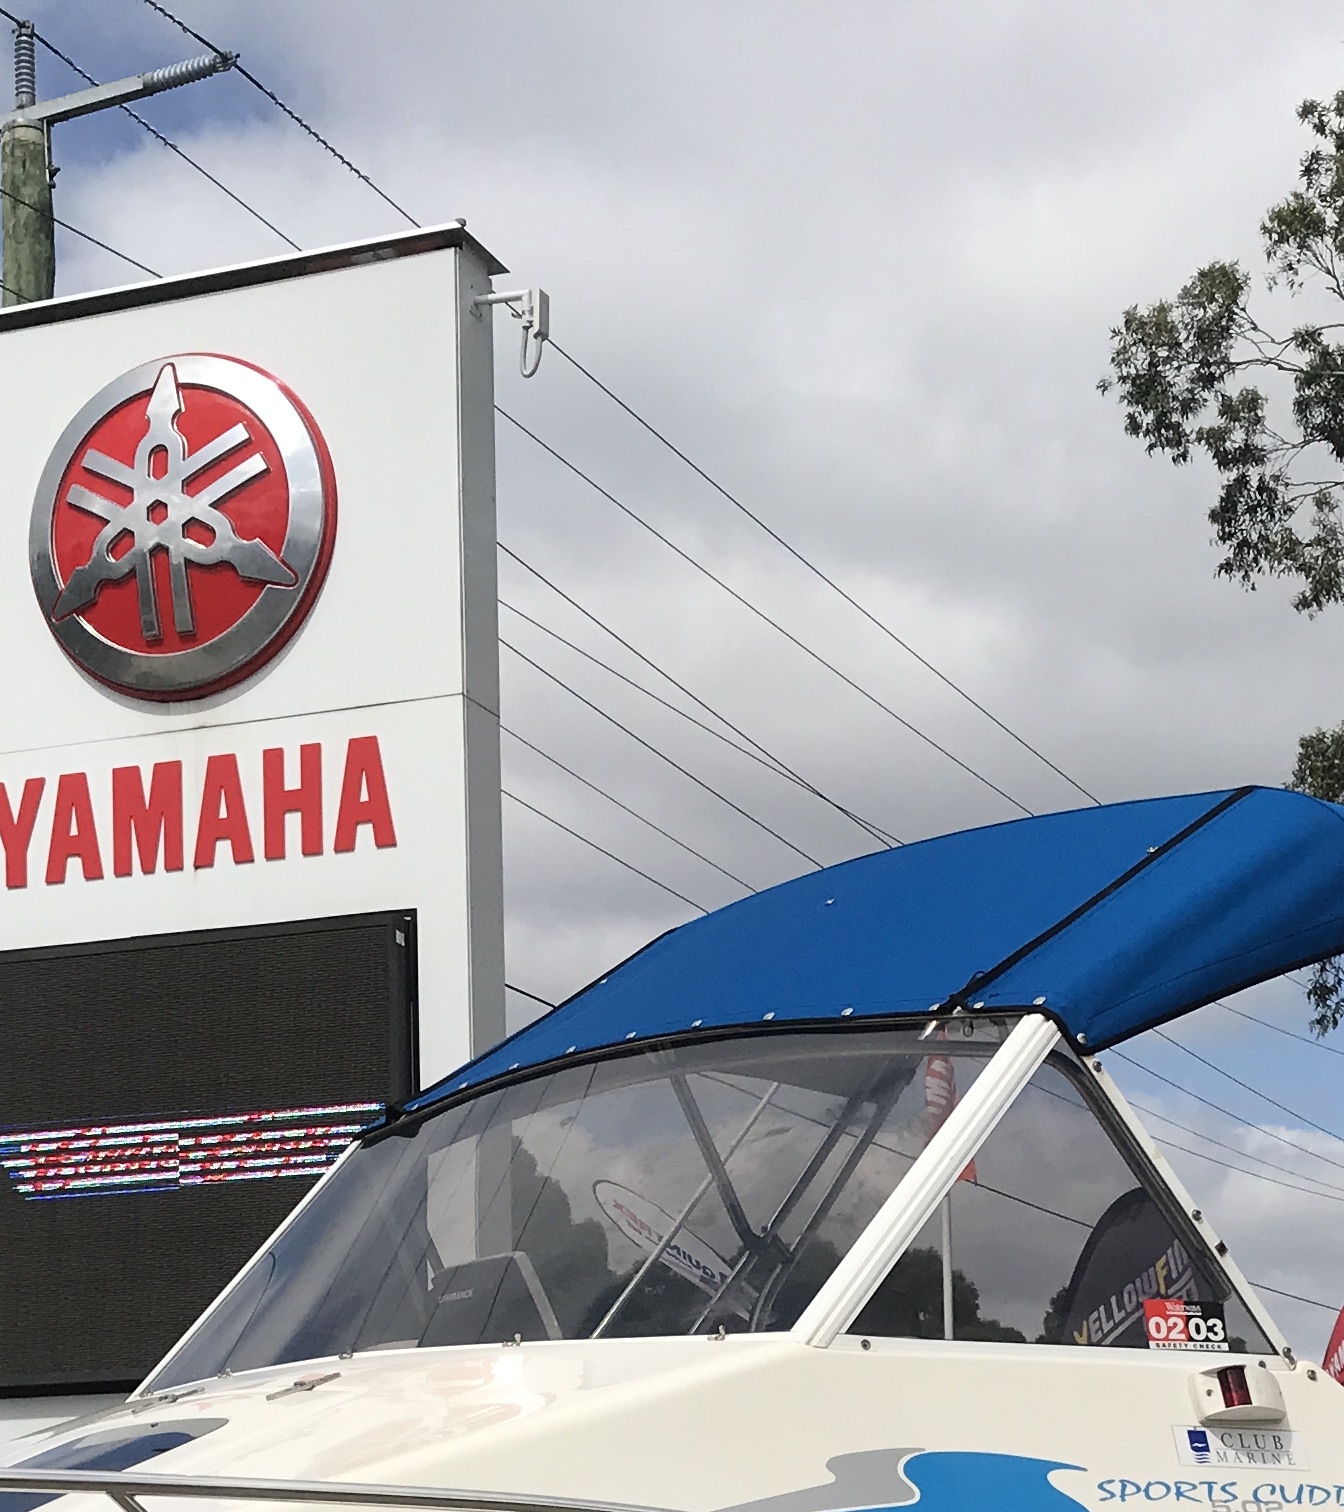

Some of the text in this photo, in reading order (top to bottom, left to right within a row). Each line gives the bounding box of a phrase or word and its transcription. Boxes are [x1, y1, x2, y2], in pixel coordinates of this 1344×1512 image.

[1148, 1316, 1225, 1342] 02 03
[1220, 1432, 1285, 1451] CLUB
[1216, 1451, 1296, 1466] MARINE
[1097, 1479, 1238, 1503] SPORTS
